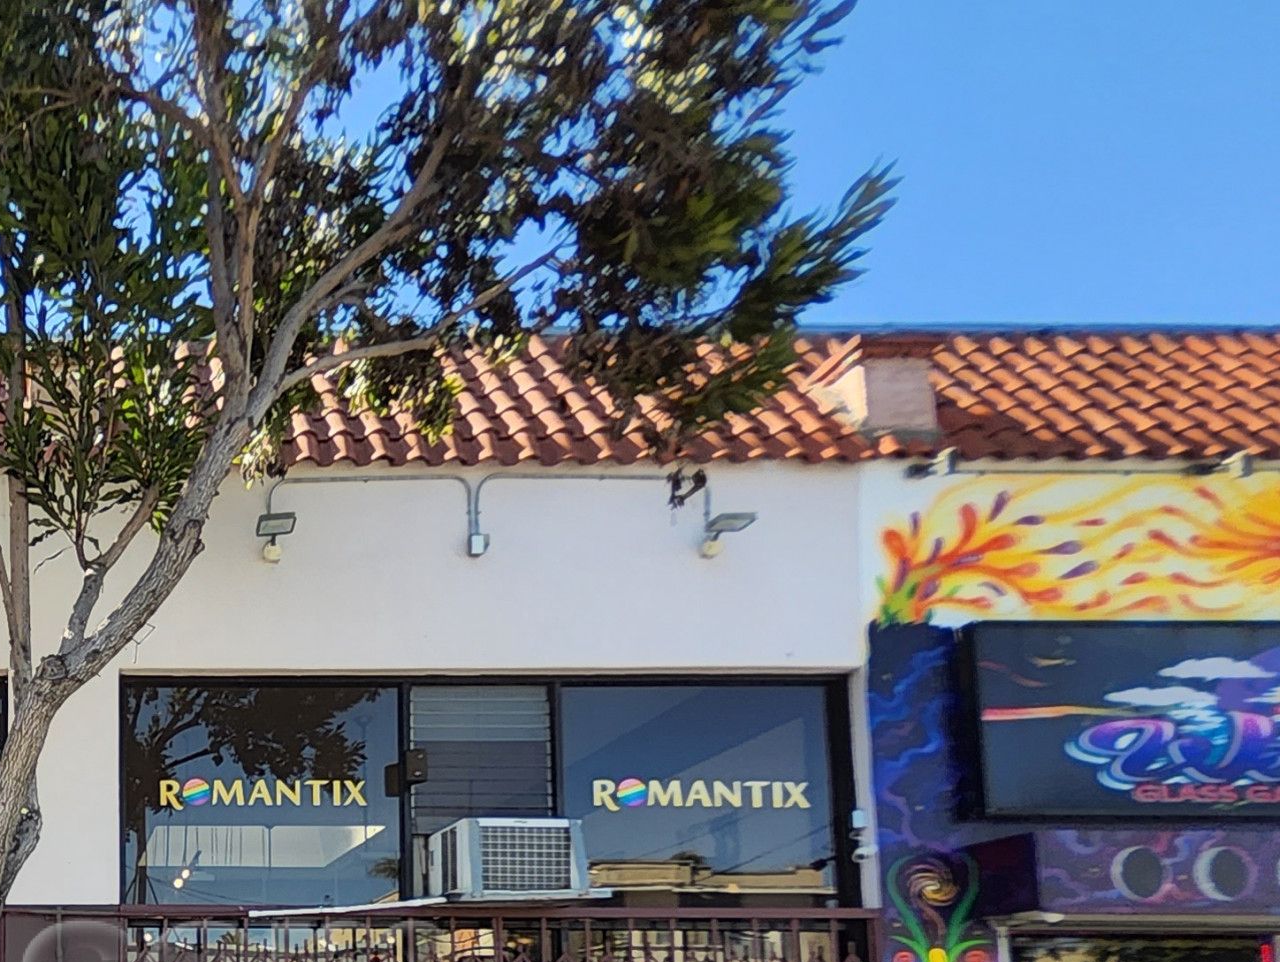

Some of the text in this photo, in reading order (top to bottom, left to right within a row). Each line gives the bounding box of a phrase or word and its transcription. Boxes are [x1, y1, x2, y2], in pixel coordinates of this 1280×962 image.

[158, 777, 368, 811] ROMANTIX
[592, 777, 811, 812] ROMANTIX
[1131, 783, 1238, 803] GLASS
